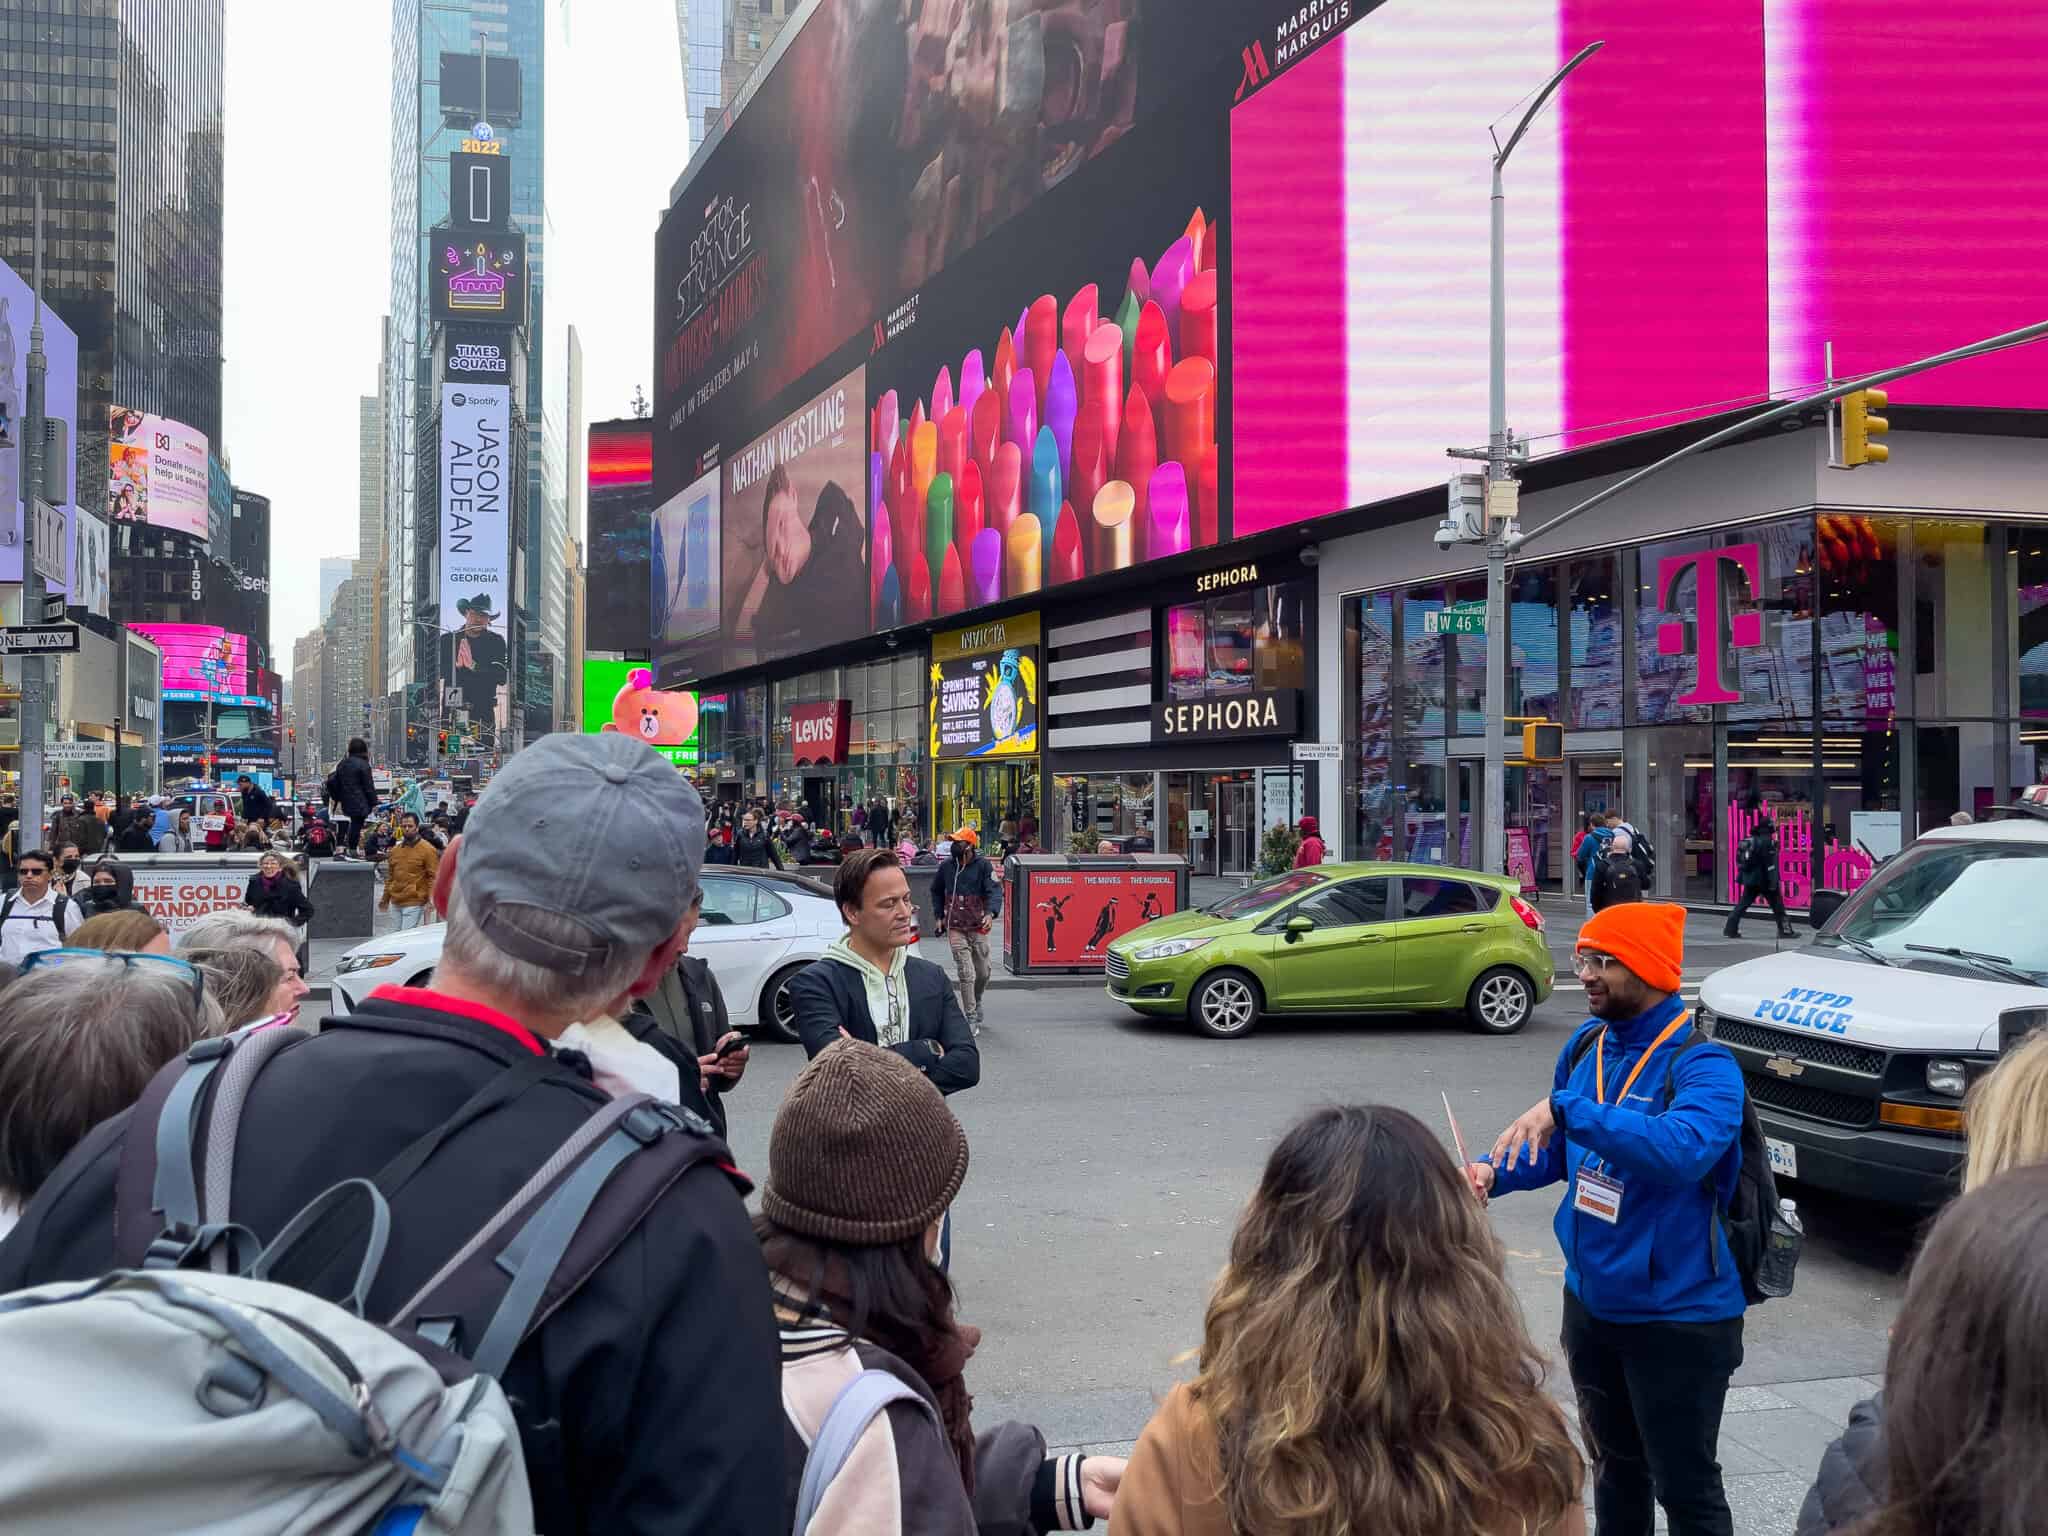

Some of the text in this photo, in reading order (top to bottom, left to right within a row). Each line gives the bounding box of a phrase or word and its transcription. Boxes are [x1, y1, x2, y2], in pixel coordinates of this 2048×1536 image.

[1277, 1, 1349, 64] MARQUIS
[462, 139, 500, 155] 2022
[690, 196, 734, 268] DOCTOR
[677, 203, 751, 320] STRANGE
[887, 293, 920, 326] MARRIOTT
[887, 311, 916, 340] MARQUIS
[456, 344, 500, 358] TIMES
[733, 345, 751, 376] MAY
[753, 340, 760, 360] 6
[449, 357, 506, 372] SQUARE
[468, 396, 500, 407] Spotify
[732, 389, 845, 496] NATHAN WESTLING
[154, 466, 174, 479] help
[477, 418, 500, 514] JASON
[450, 440, 473, 553] ALDEAN
[191, 559, 201, 601] 1500
[450, 573, 499, 584] GEORGIA
[1196, 564, 1258, 593] SEPHORA
[1440, 615, 1451, 630] W
[1456, 615, 1472, 631] 46
[37, 634, 66, 645] WAY
[961, 623, 1007, 649] INVICTA
[942, 690, 980, 713] SAVINGS
[1164, 697, 1278, 734] SEPHORA
[966, 730, 980, 743] FREE
[675, 751, 699, 761] FRIE
[1035, 876, 1049, 885] THE
[1084, 876, 1098, 885] THE
[1130, 876, 1143, 885] THE
[132, 884, 241, 900] THE GOLD
[143, 902, 240, 917] TANDAR
[1781, 987, 1853, 1009] NYPD
[1754, 999, 1853, 1034] POLICE
